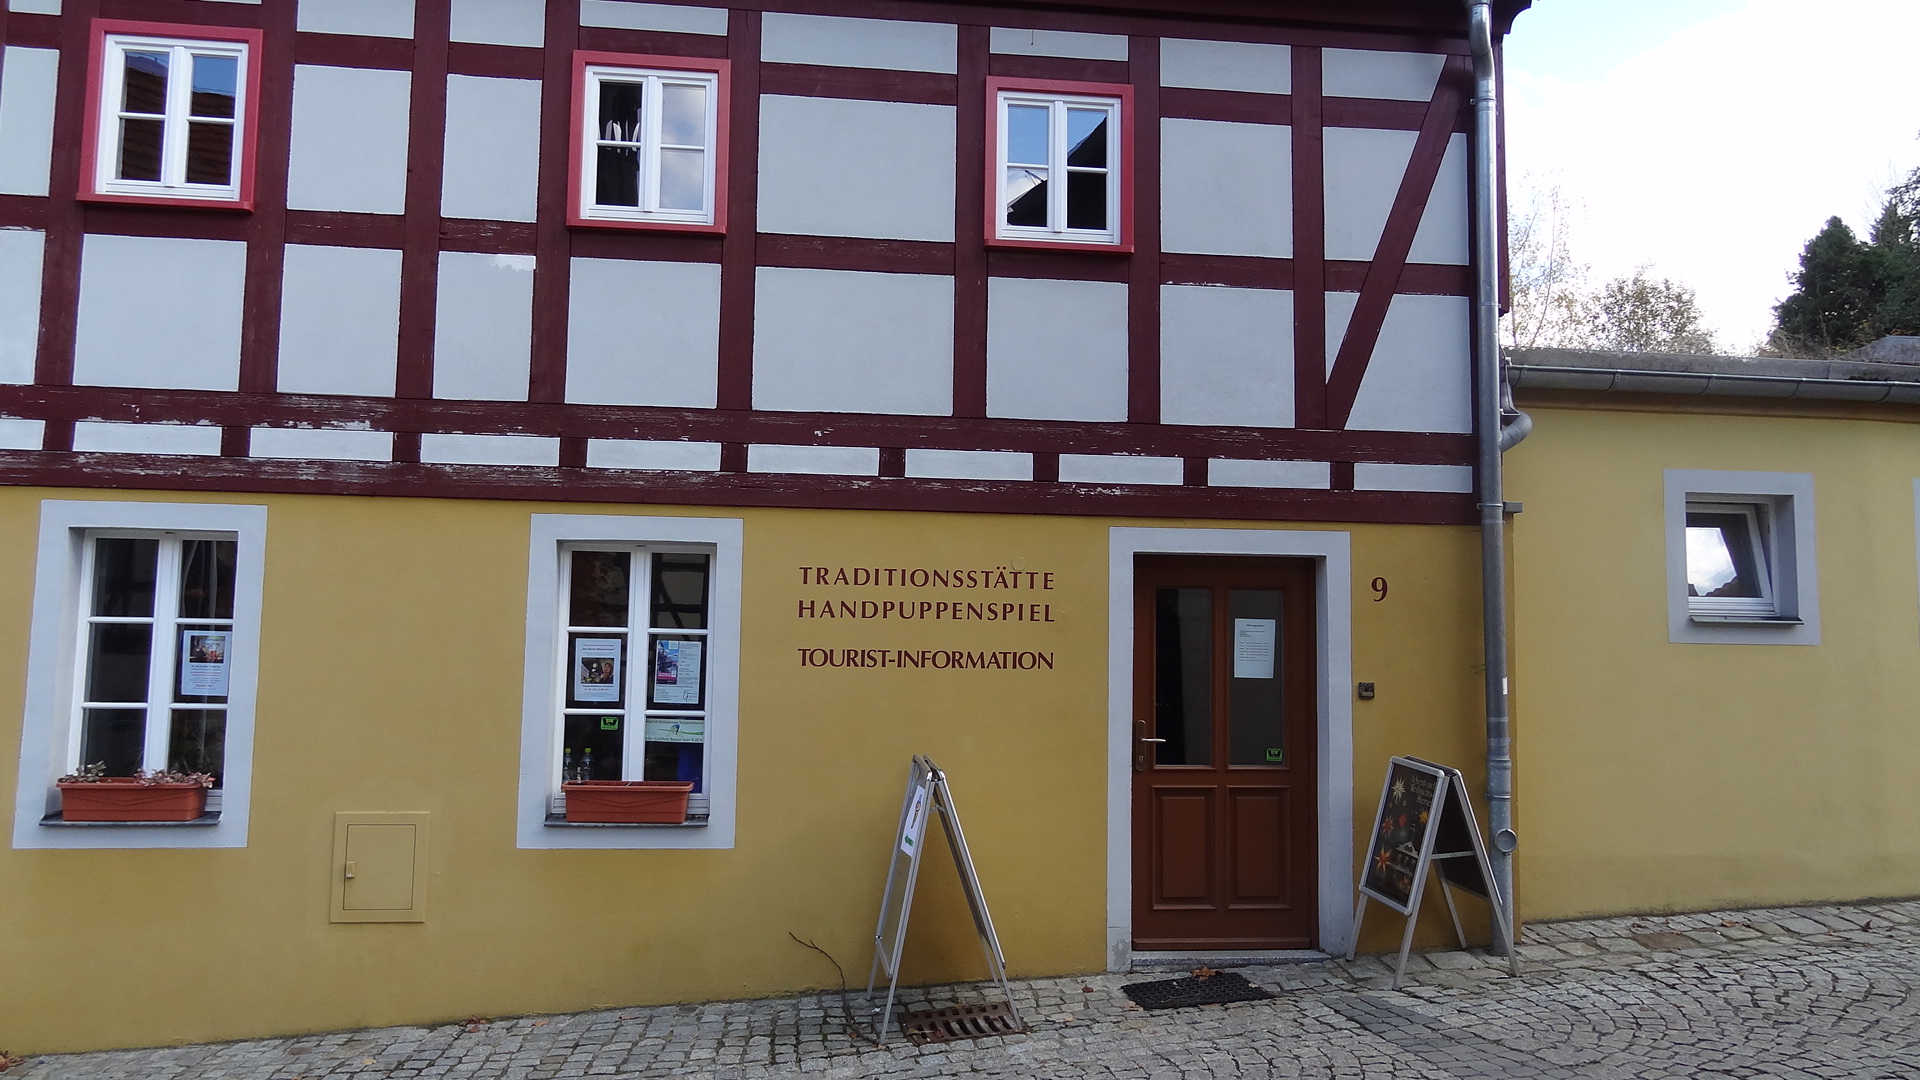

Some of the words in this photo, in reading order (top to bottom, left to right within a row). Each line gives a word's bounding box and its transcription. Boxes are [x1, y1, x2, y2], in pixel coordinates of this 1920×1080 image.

[798, 566, 1055, 590] TRADITIONSSTÄTTE
[1371, 576, 1388, 602] 9
[798, 600, 1055, 622] HANDPUPPENSPIEL
[798, 648, 1054, 670] TOURIST-INFORMATION
